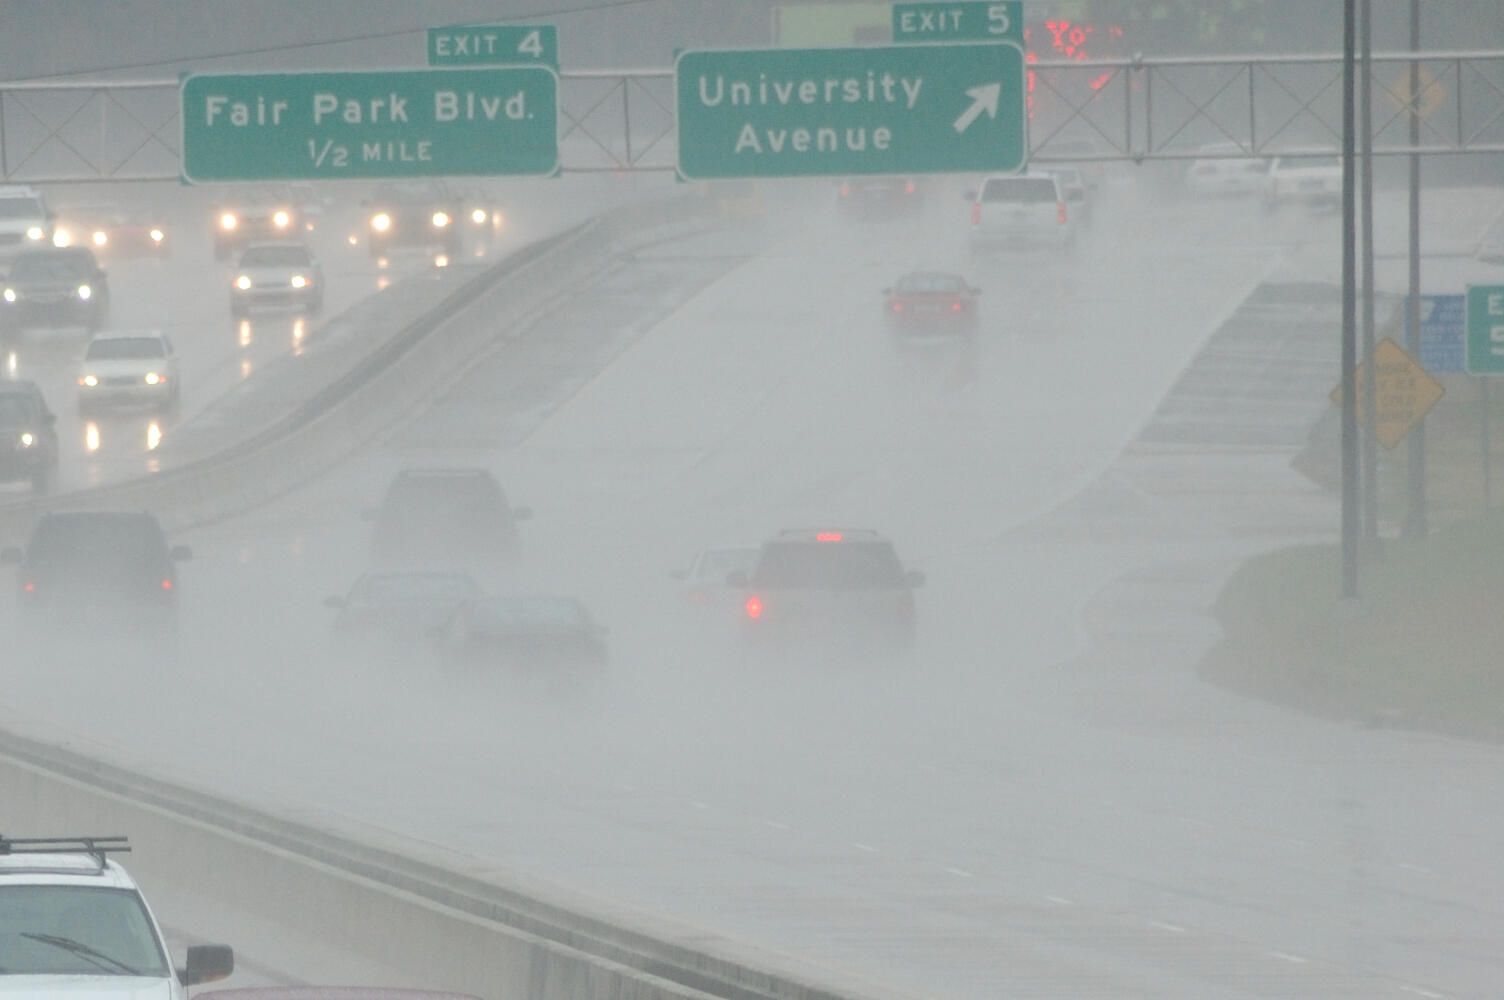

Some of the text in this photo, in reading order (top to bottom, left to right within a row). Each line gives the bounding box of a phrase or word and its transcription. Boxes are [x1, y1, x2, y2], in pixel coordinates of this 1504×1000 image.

[900, 4, 1011, 34] EXIT 5
[435, 30, 544, 58] EXIT 4
[699, 71, 923, 108] University
[206, 90, 535, 127] Fair Park Blvd.
[362, 141, 433, 162] MILE
[734, 123, 893, 153] Avenue
